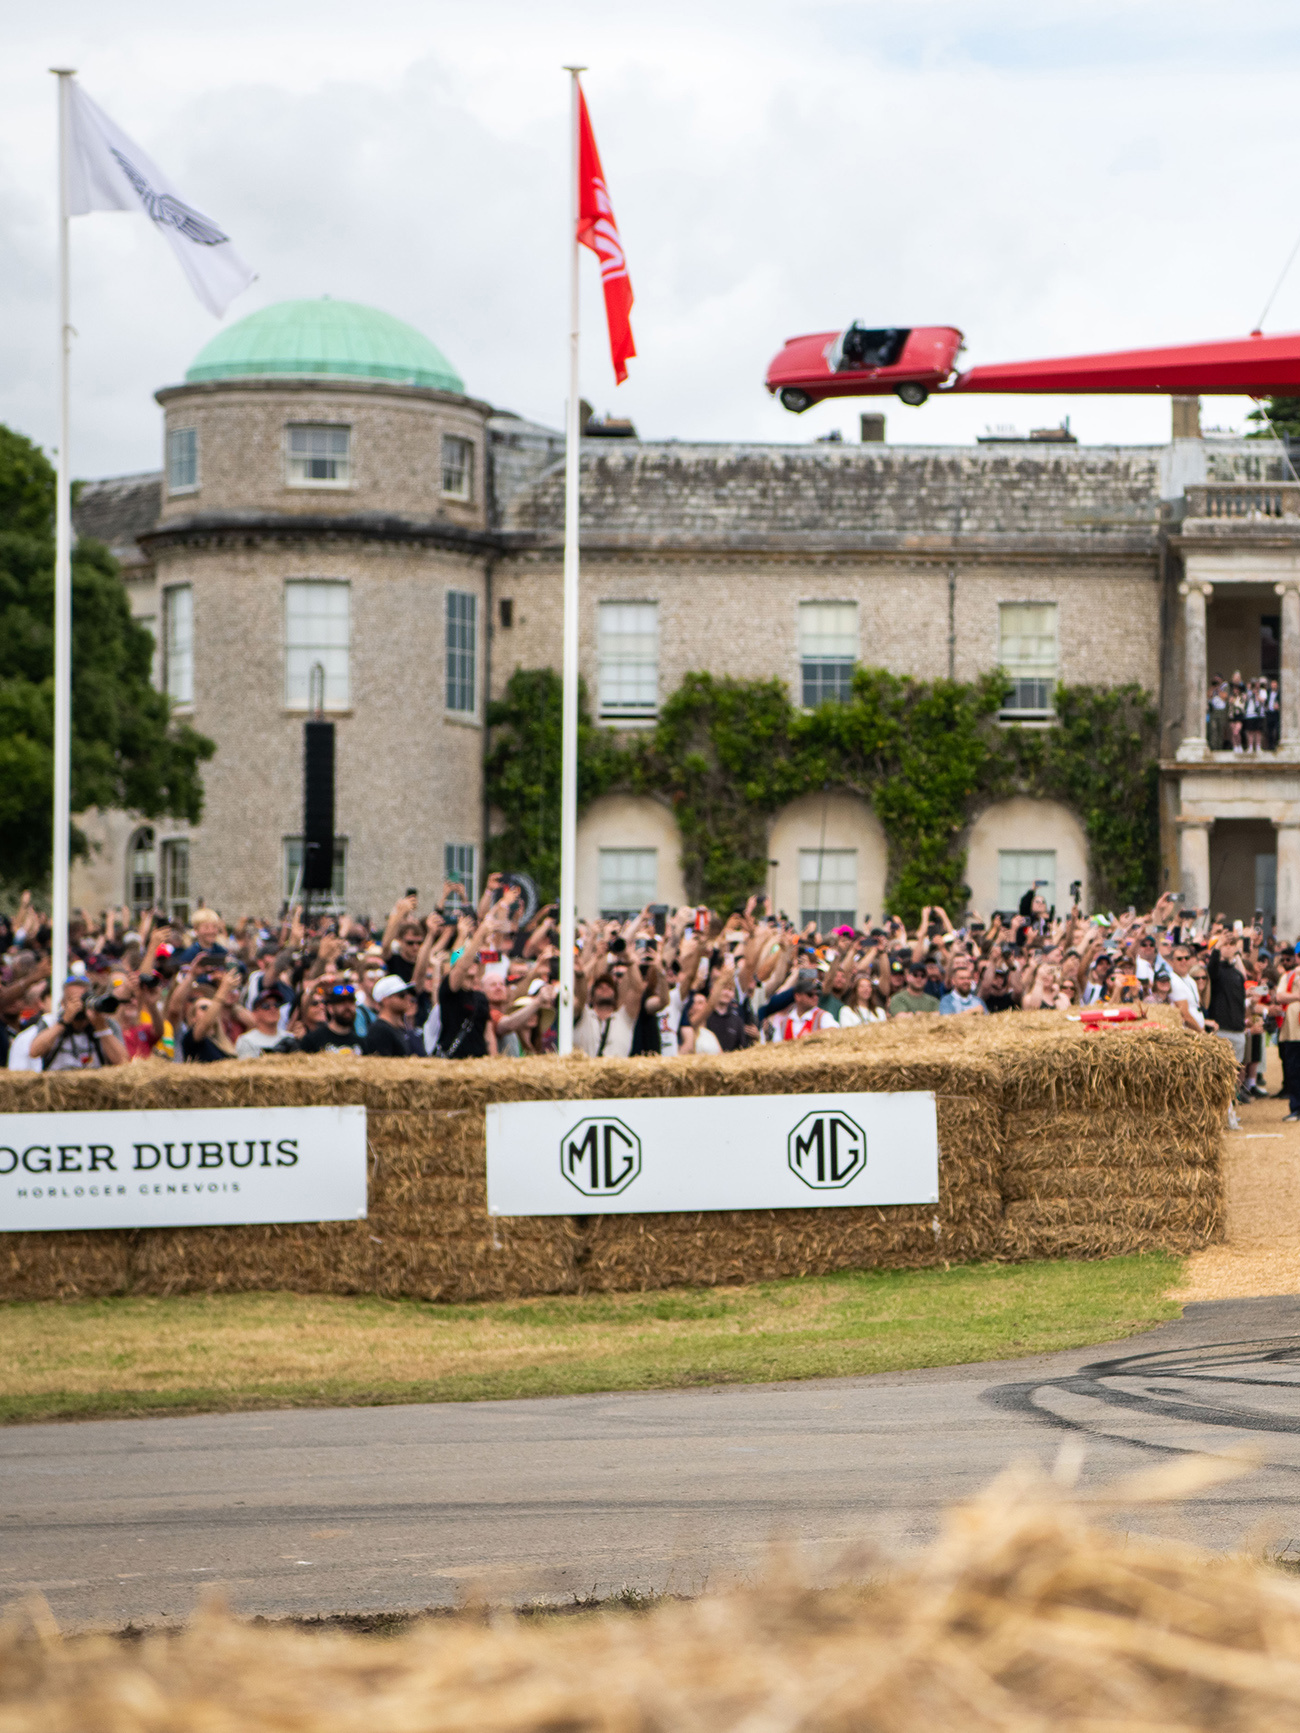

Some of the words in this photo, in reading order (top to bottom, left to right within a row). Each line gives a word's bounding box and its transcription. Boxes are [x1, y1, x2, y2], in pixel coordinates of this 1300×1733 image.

[132, 1138, 300, 1171] DUBUIS
[569, 1125, 633, 1189] MG
[796, 1118, 860, 1182] MG
[138, 1181, 241, 1196] GENEVOIS
